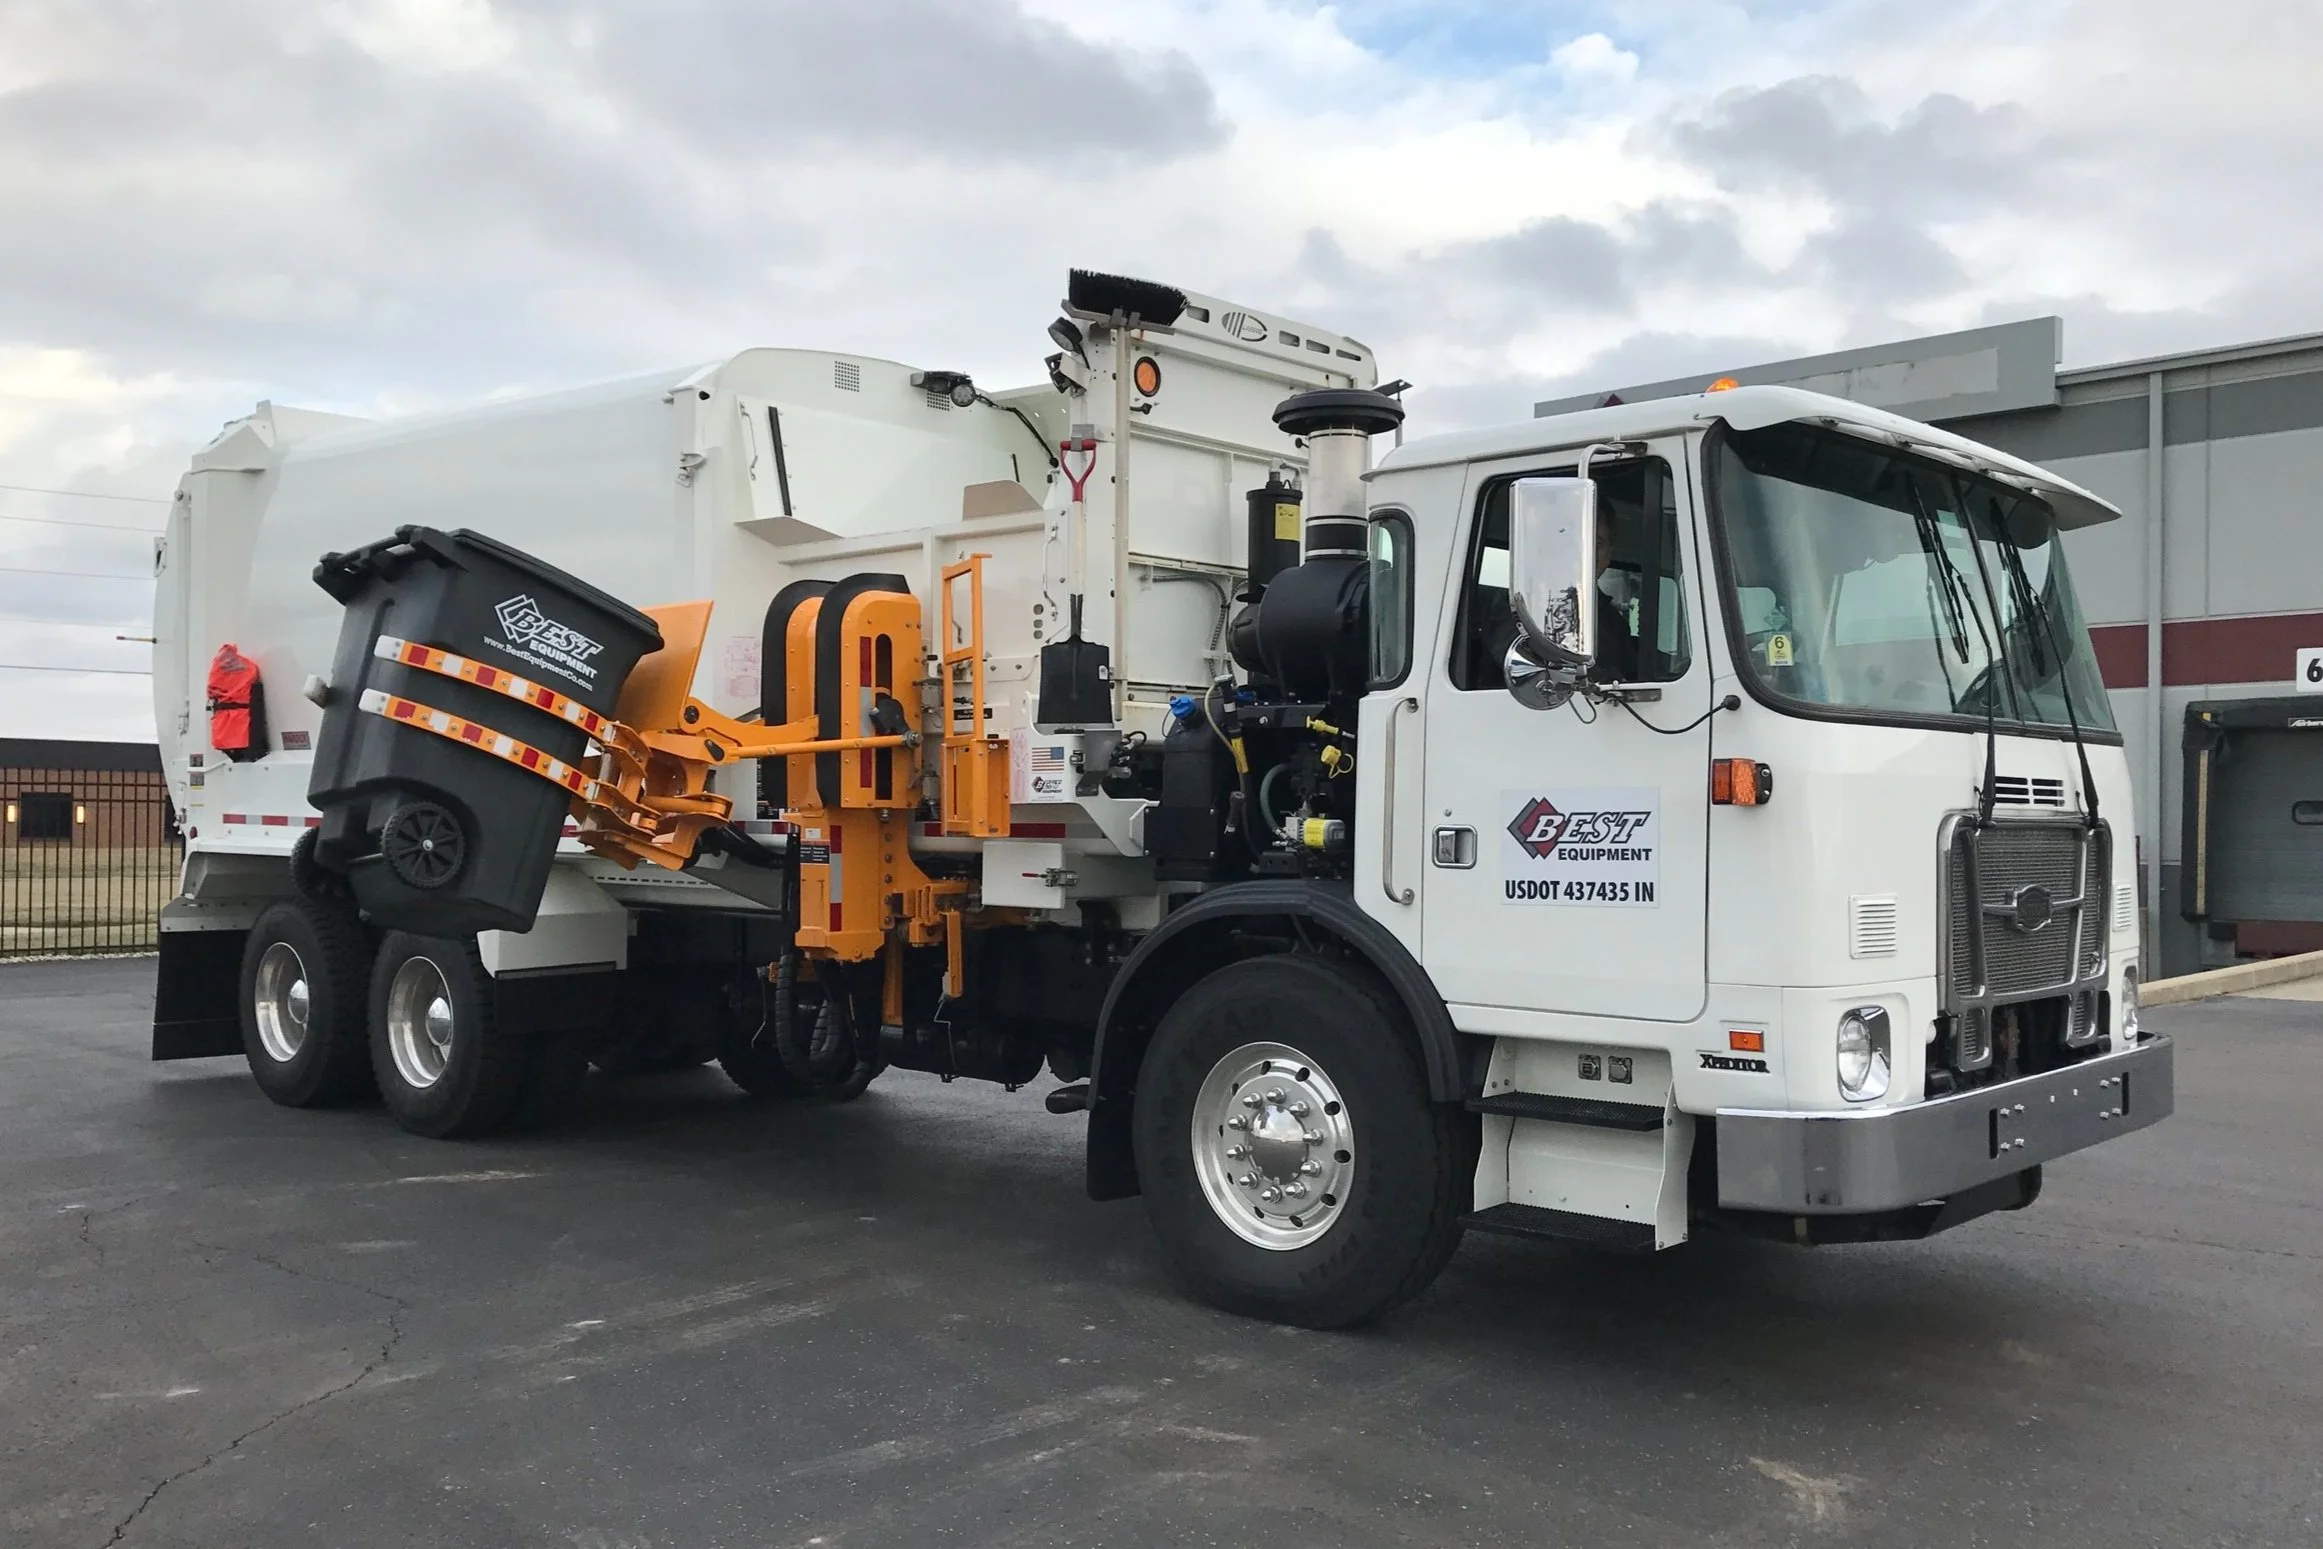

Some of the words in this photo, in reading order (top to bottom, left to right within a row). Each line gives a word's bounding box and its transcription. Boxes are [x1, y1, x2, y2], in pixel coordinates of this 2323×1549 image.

[510, 608, 604, 660] BEST
[1774, 636, 1785, 649] 6
[484, 636, 593, 692] www.BestEquipmentCo.com
[529, 640, 598, 679] EQUIPMENT
[2306, 658, 2323, 683] 6
[1525, 812, 1652, 843] BEST
[1558, 848, 1652, 861] EQUIPMENT
[1505, 880, 1560, 900] USDOT
[1564, 881, 1629, 901] 437435
[1634, 882, 1654, 902] IN
